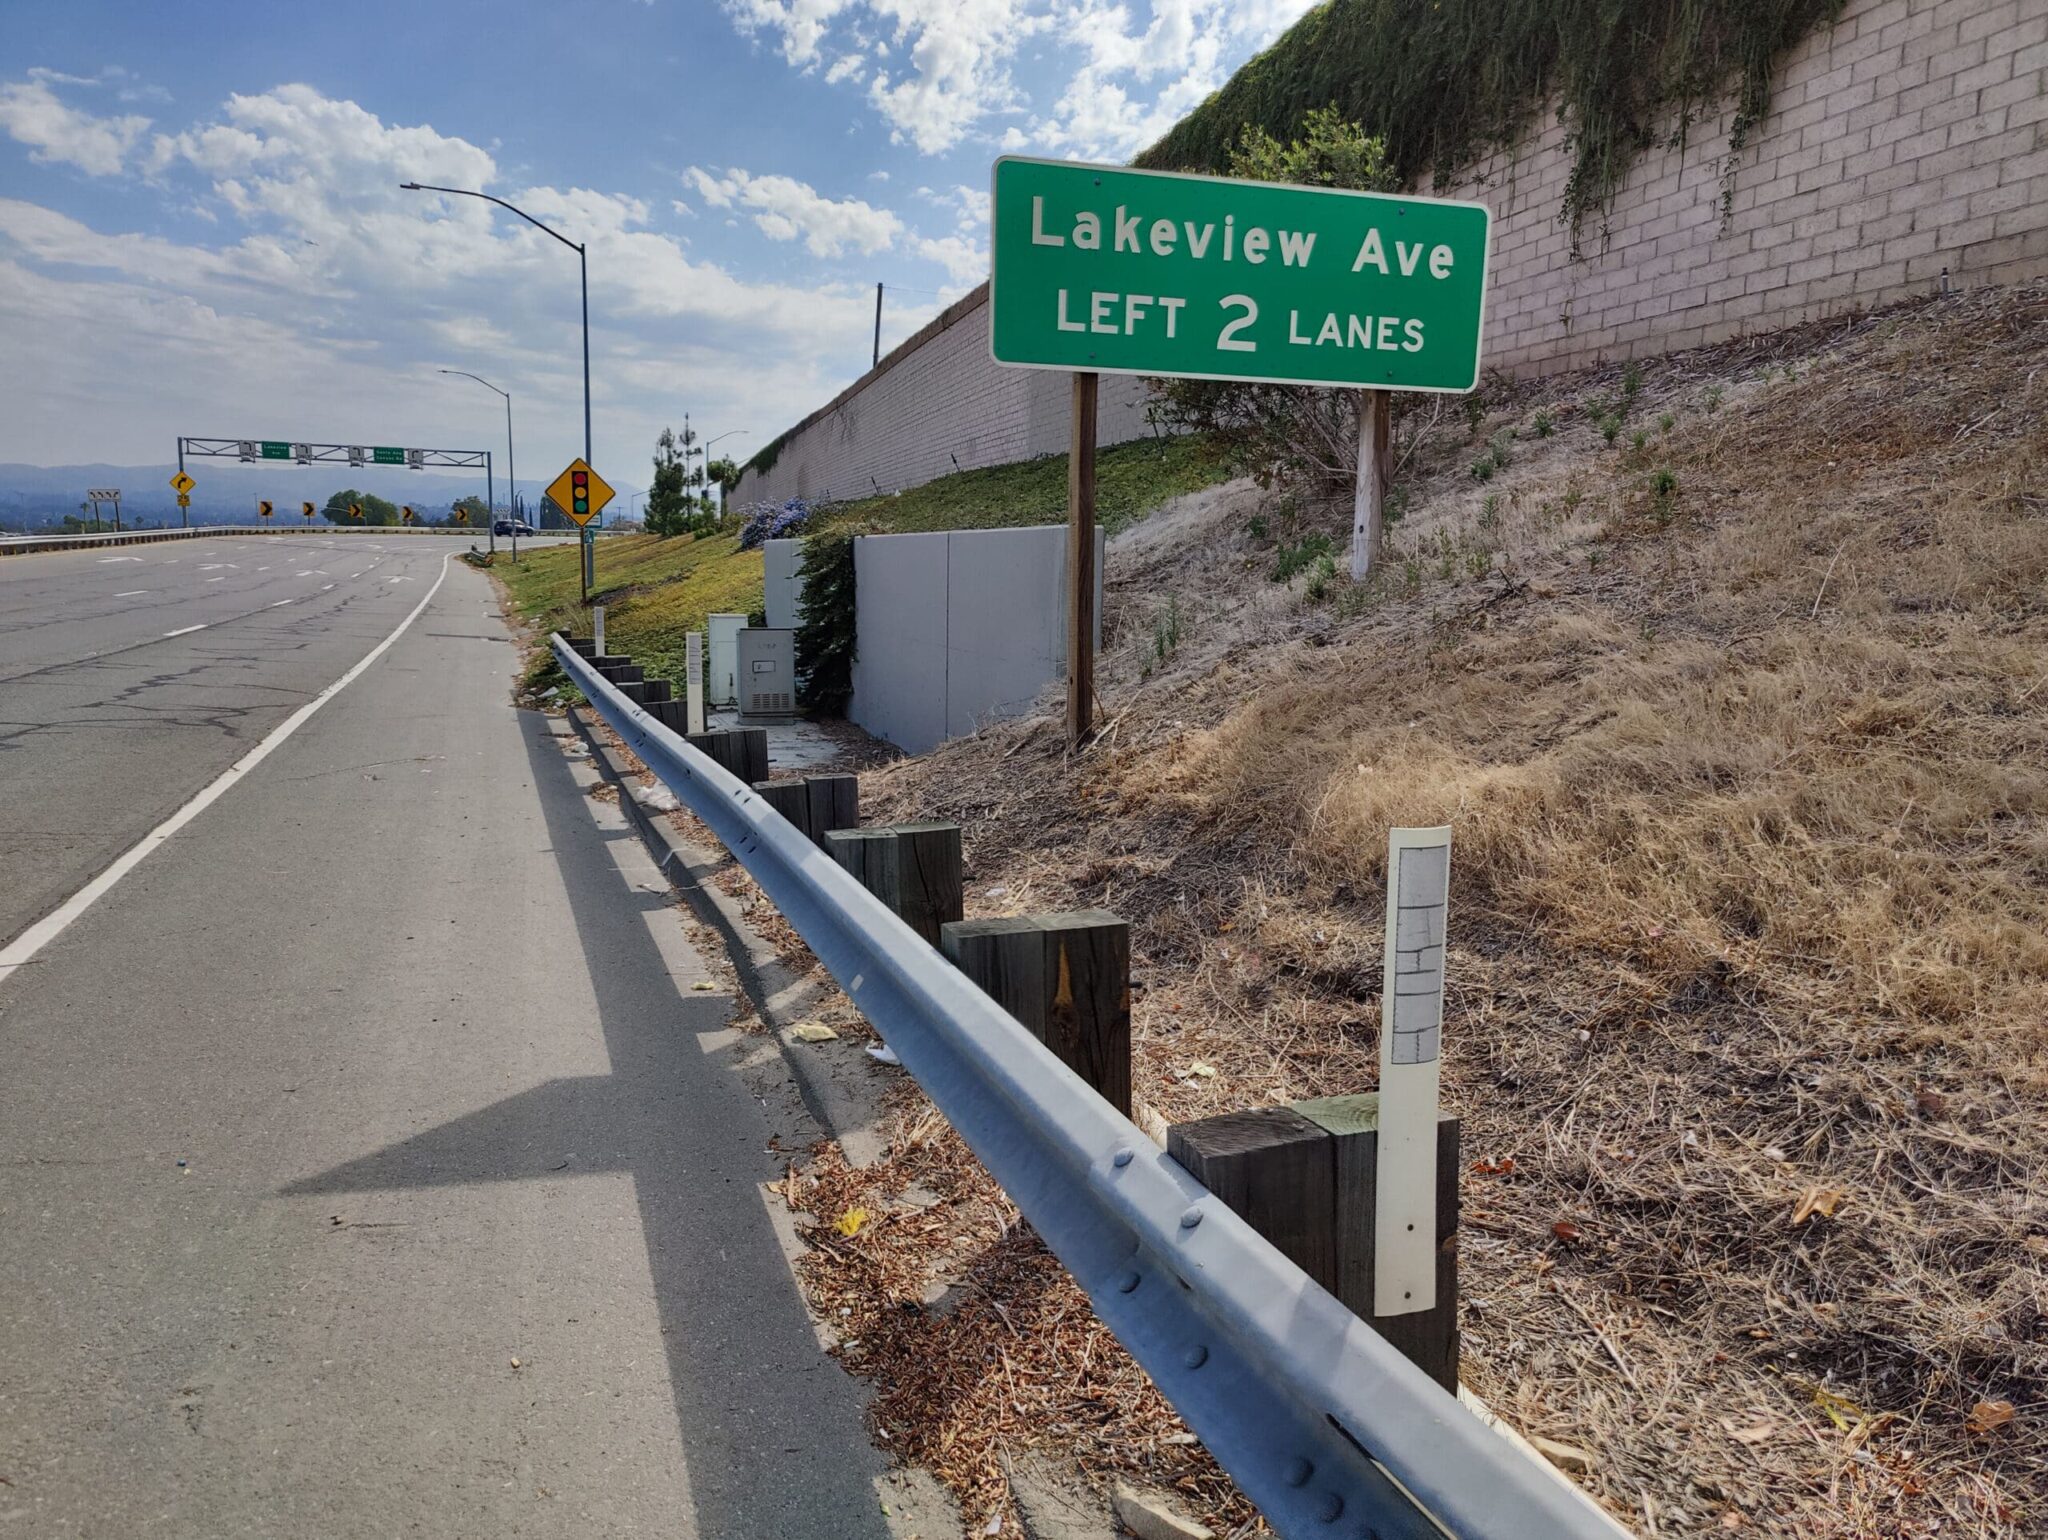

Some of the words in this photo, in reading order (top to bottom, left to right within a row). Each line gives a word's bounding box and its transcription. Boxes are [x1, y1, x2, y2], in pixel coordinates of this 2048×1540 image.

[1031, 195, 1317, 267] Lakeview
[1351, 227, 1455, 280] Ave
[1057, 288, 1186, 338] LEFT
[1216, 293, 1258, 353] 2
[1289, 309, 1424, 353] LANES
